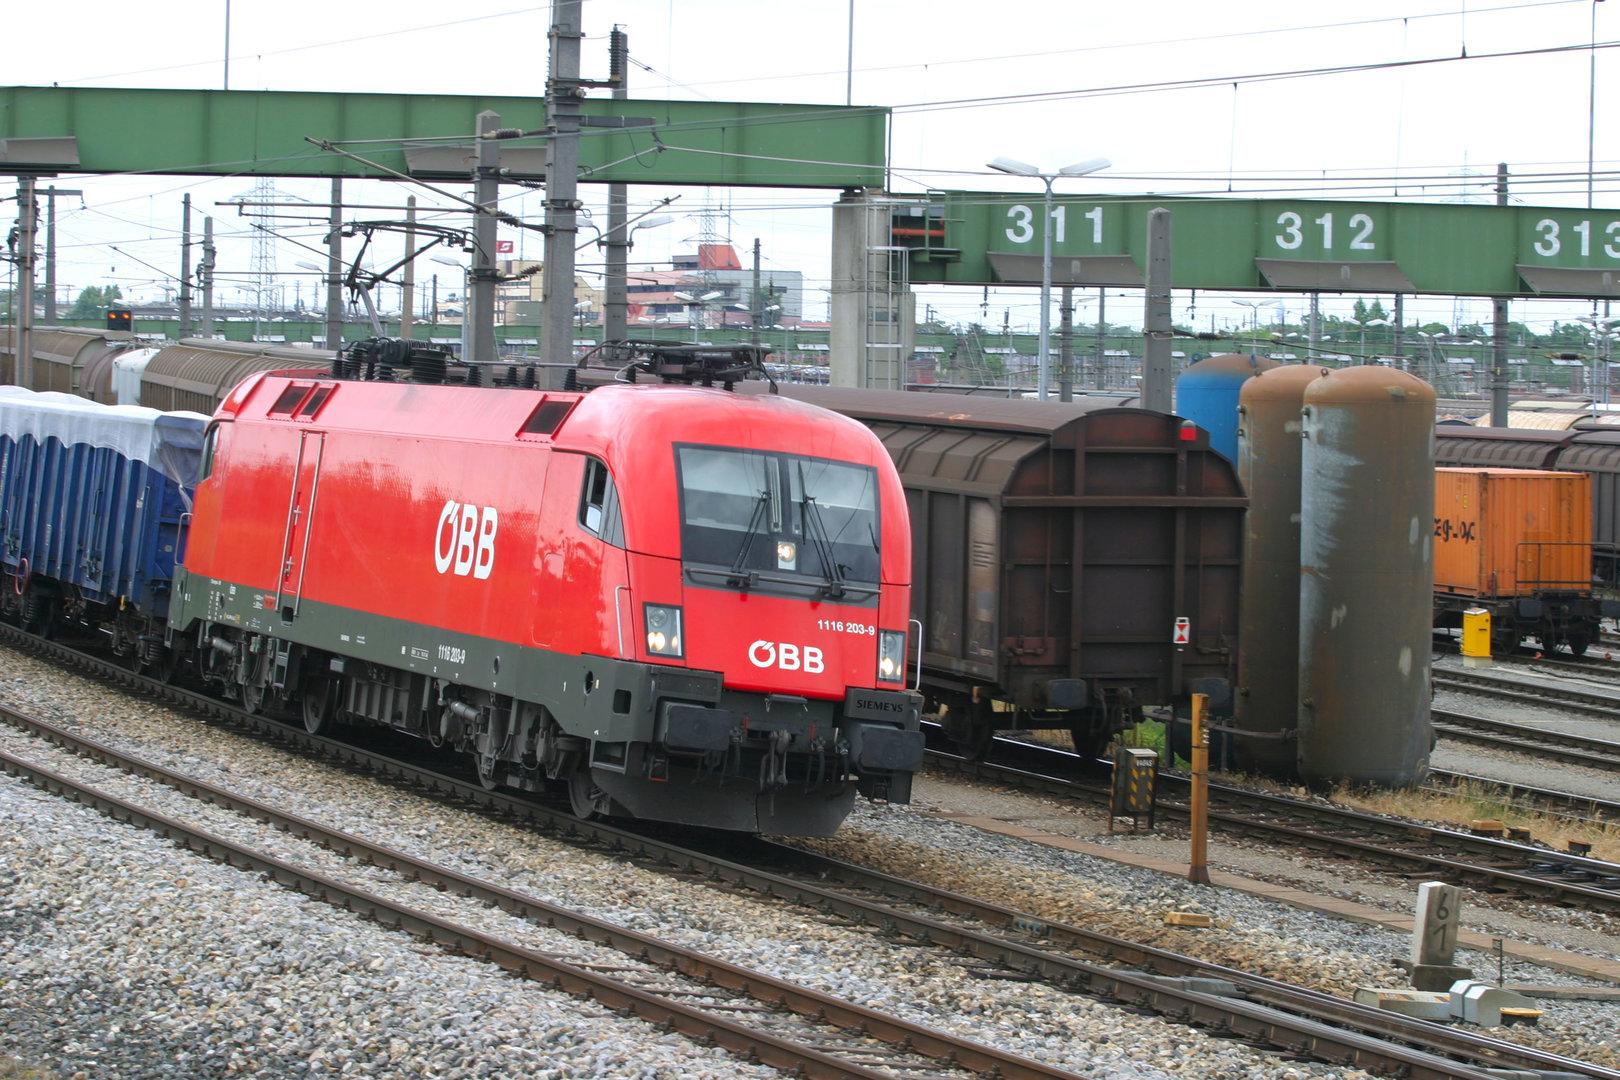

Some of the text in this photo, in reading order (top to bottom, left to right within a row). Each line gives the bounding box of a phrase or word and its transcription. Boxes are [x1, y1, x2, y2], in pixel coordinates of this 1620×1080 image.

[1005, 204, 1103, 244] 311
[1275, 211, 1376, 250] 312
[1534, 218, 1620, 259] 313
[434, 499, 499, 580] ÖBB
[817, 619, 875, 636] 1116 203-9
[438, 644, 452, 662] 1116
[450, 647, 467, 665] 203-9
[748, 640, 825, 674] ÖBB
[856, 699, 904, 713] SIEMENS
[1436, 892, 1450, 920] 6
[1433, 923, 1448, 951] 1
